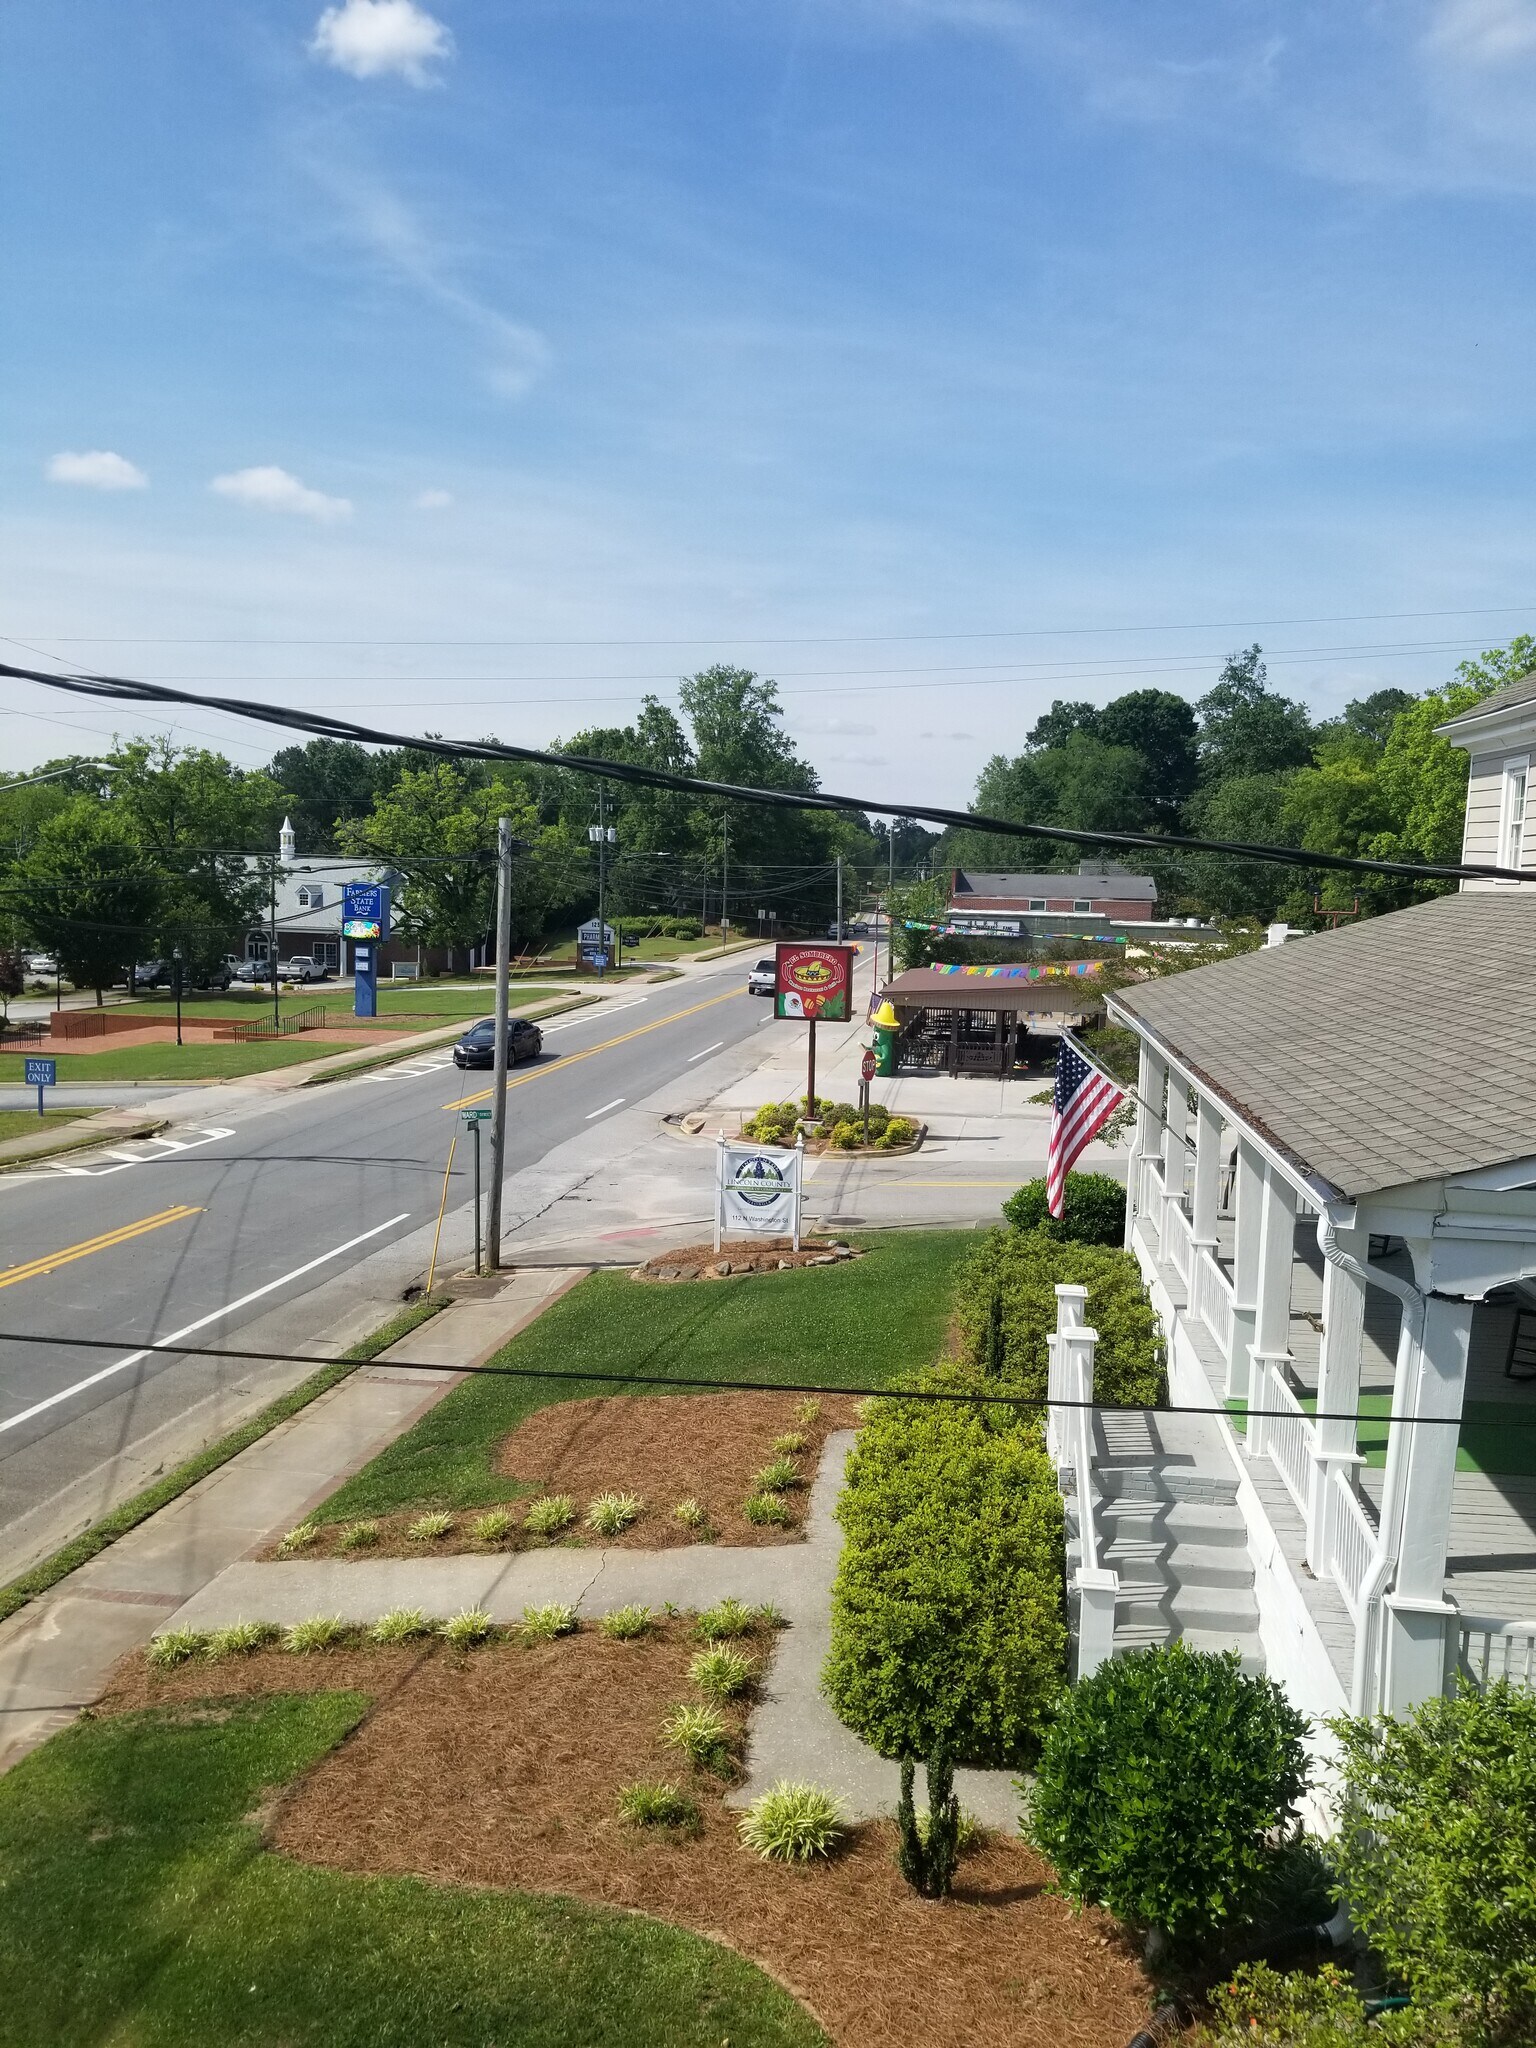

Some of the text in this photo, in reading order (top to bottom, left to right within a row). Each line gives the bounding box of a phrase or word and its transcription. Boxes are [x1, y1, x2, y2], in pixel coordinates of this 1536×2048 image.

[350, 897, 374, 905] STATE
[354, 904, 372, 912] BANK
[583, 932, 609, 940] PHARMY
[788, 950, 838, 966] EL SOMBRERO
[29, 1062, 51, 1072] EXIT
[862, 1059, 875, 1073] STOP
[27, 1072, 51, 1082] ONLY
[461, 1111, 478, 1119] WARD
[727, 1178, 792, 1188] LINCOLN COUNTY
[748, 1215, 781, 1223] Washington
